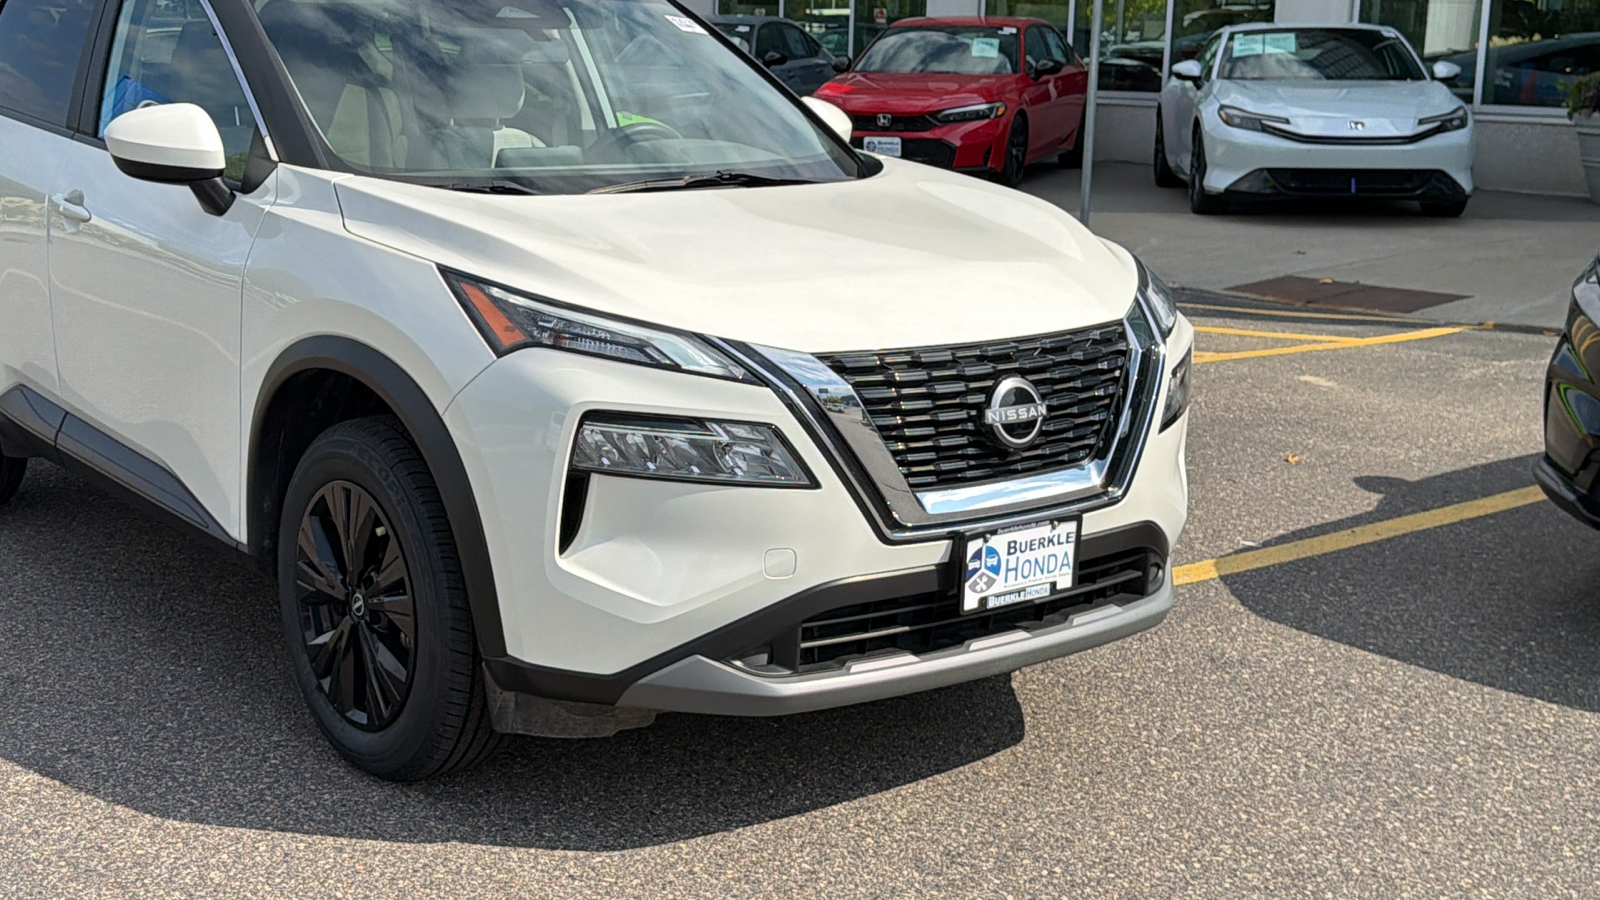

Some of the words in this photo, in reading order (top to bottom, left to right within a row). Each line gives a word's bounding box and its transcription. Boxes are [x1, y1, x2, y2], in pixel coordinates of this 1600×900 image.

[988, 403, 1047, 422] NISSAN
[1006, 531, 1075, 556] BUERKLE
[1004, 550, 1071, 584] HONDA
[988, 591, 1026, 606] BUERKLE
[1026, 586, 1048, 598] HONDA
